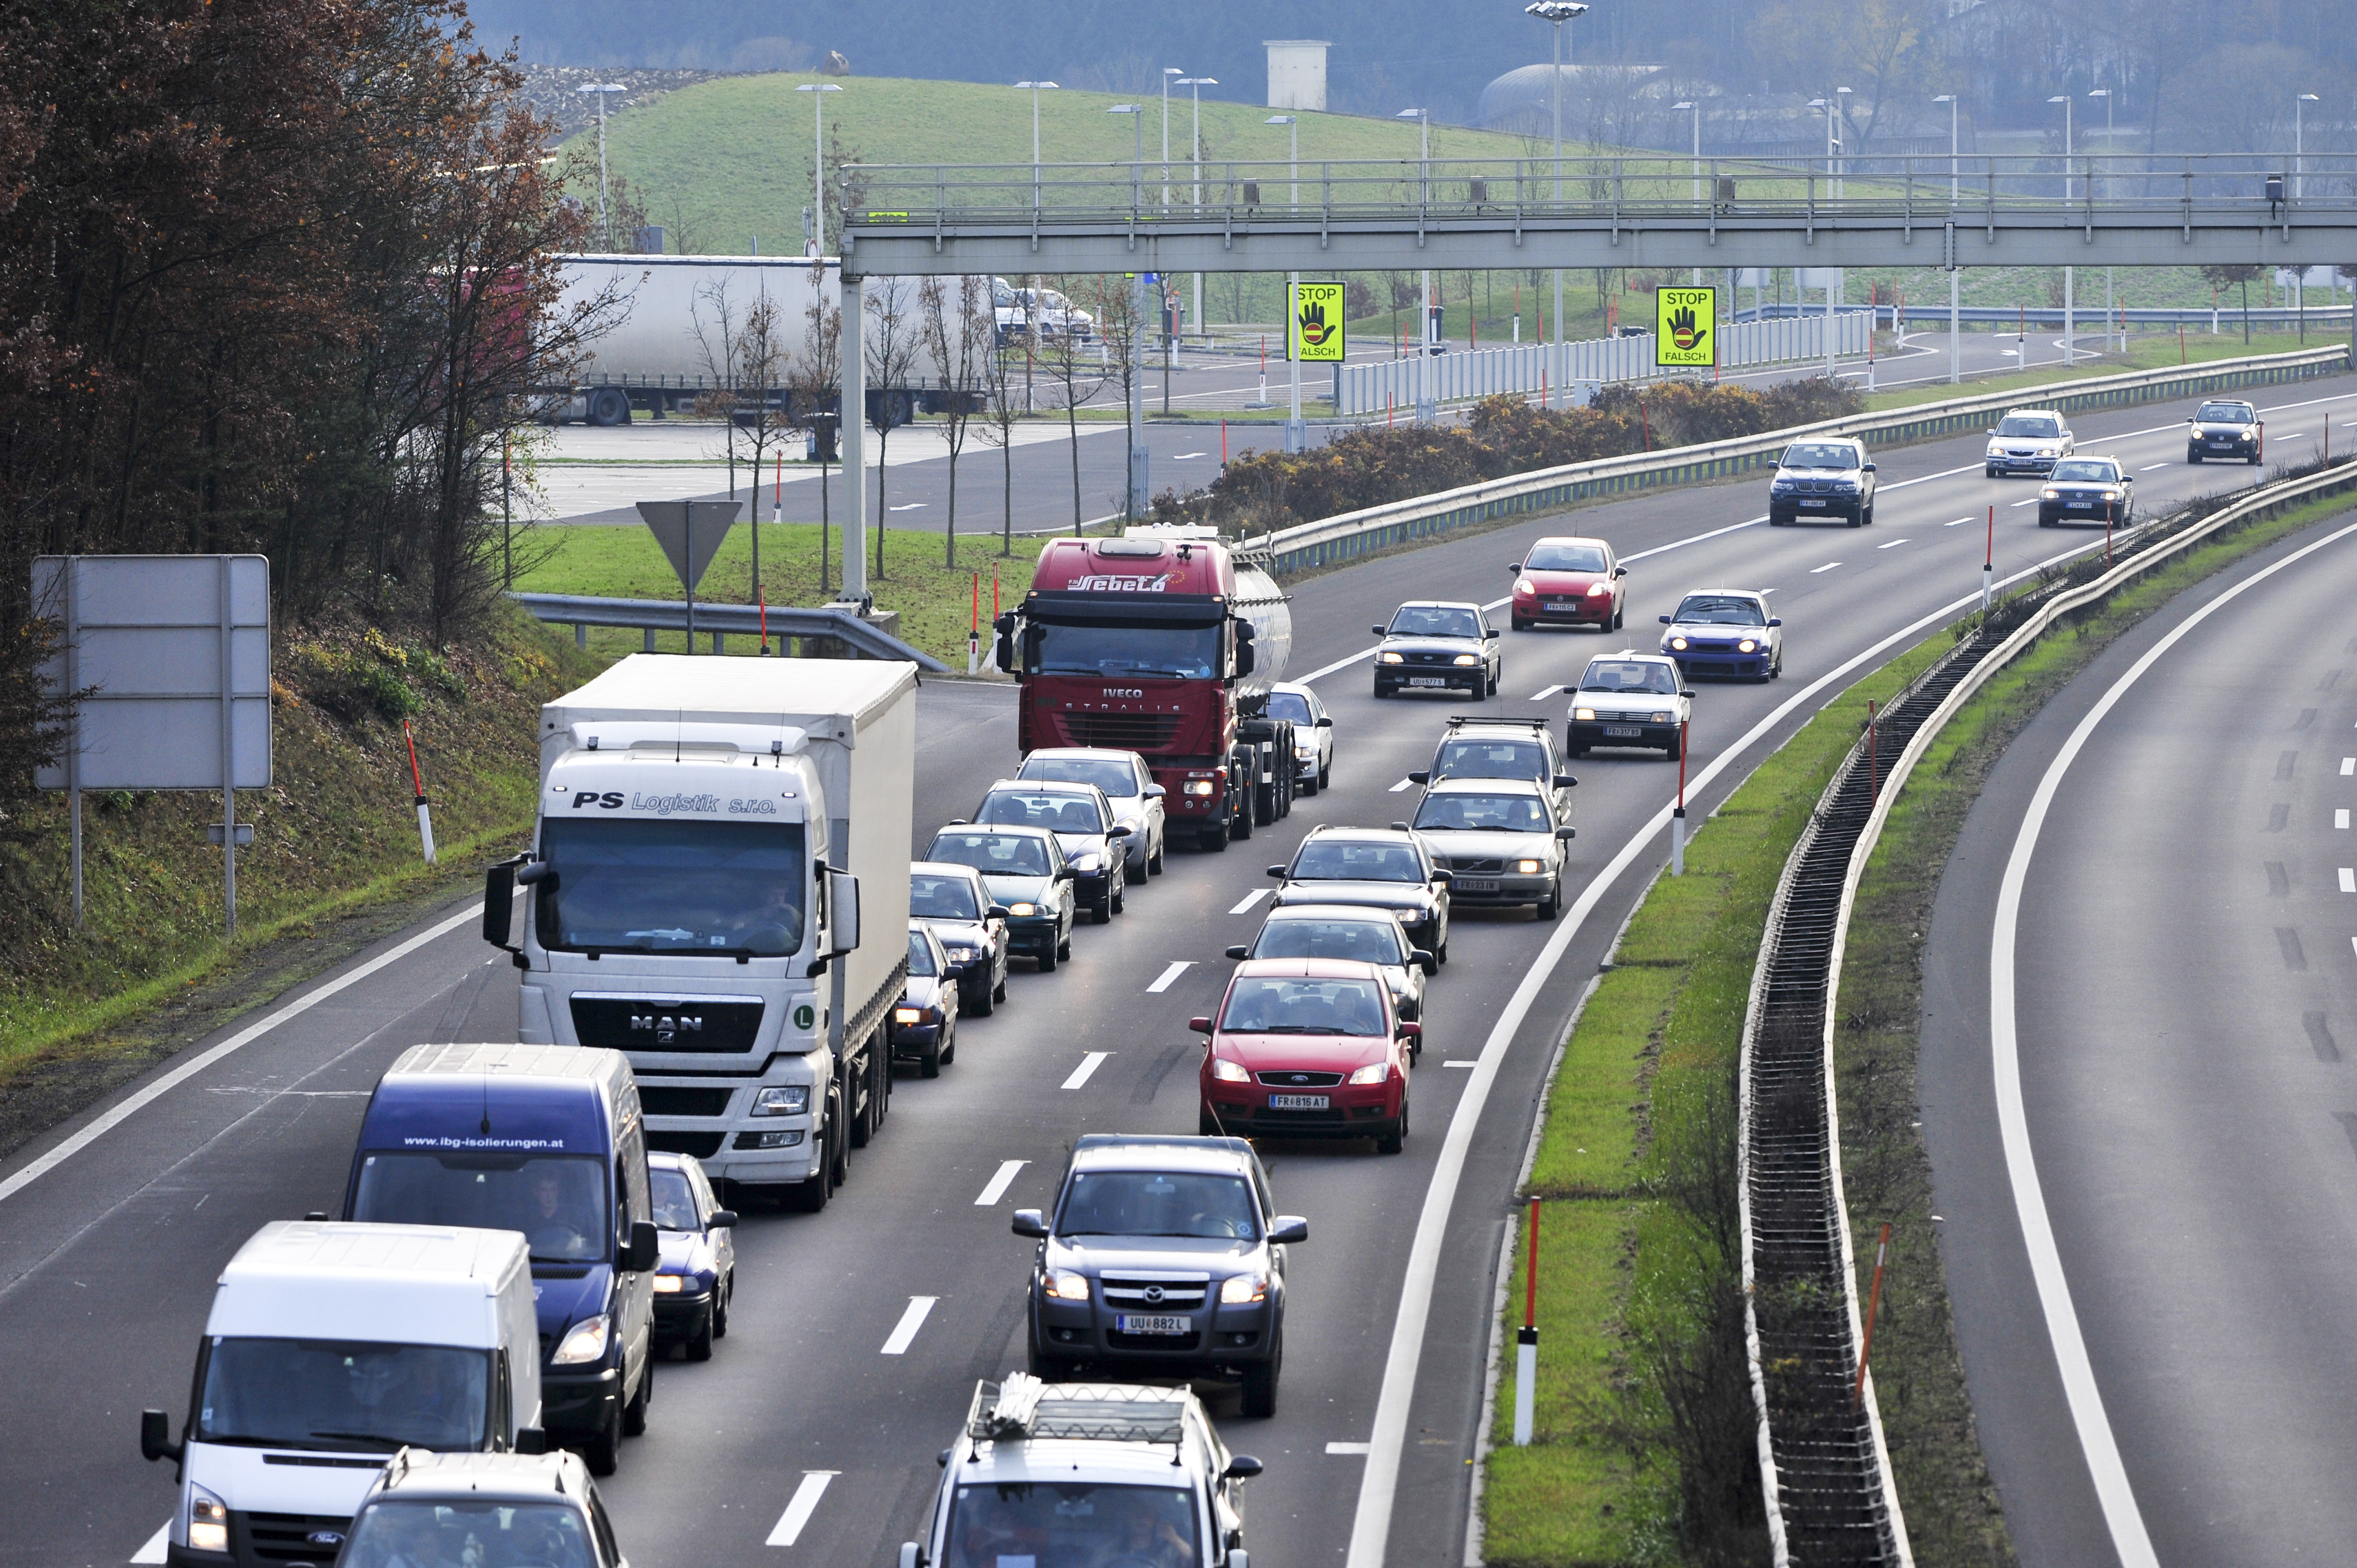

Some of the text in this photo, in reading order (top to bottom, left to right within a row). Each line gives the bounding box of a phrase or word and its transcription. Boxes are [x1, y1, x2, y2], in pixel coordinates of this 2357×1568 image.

[1298, 288, 1336, 300] STOP
[1667, 292, 1707, 305] STOP
[1665, 352, 1706, 361] FALSCH
[1103, 688, 1143, 699] IVECO
[1066, 703, 1180, 712] STRALIS
[572, 792, 776, 815] PS Logistik s.r.o.
[631, 1015, 702, 1031] MAN
[800, 1009, 810, 1026] L
[1278, 1097, 1326, 1107] FR 816 AT
[404, 1137, 564, 1149] www.ibg-isolierungen.at
[1130, 1318, 1182, 1329] UU 882 L
